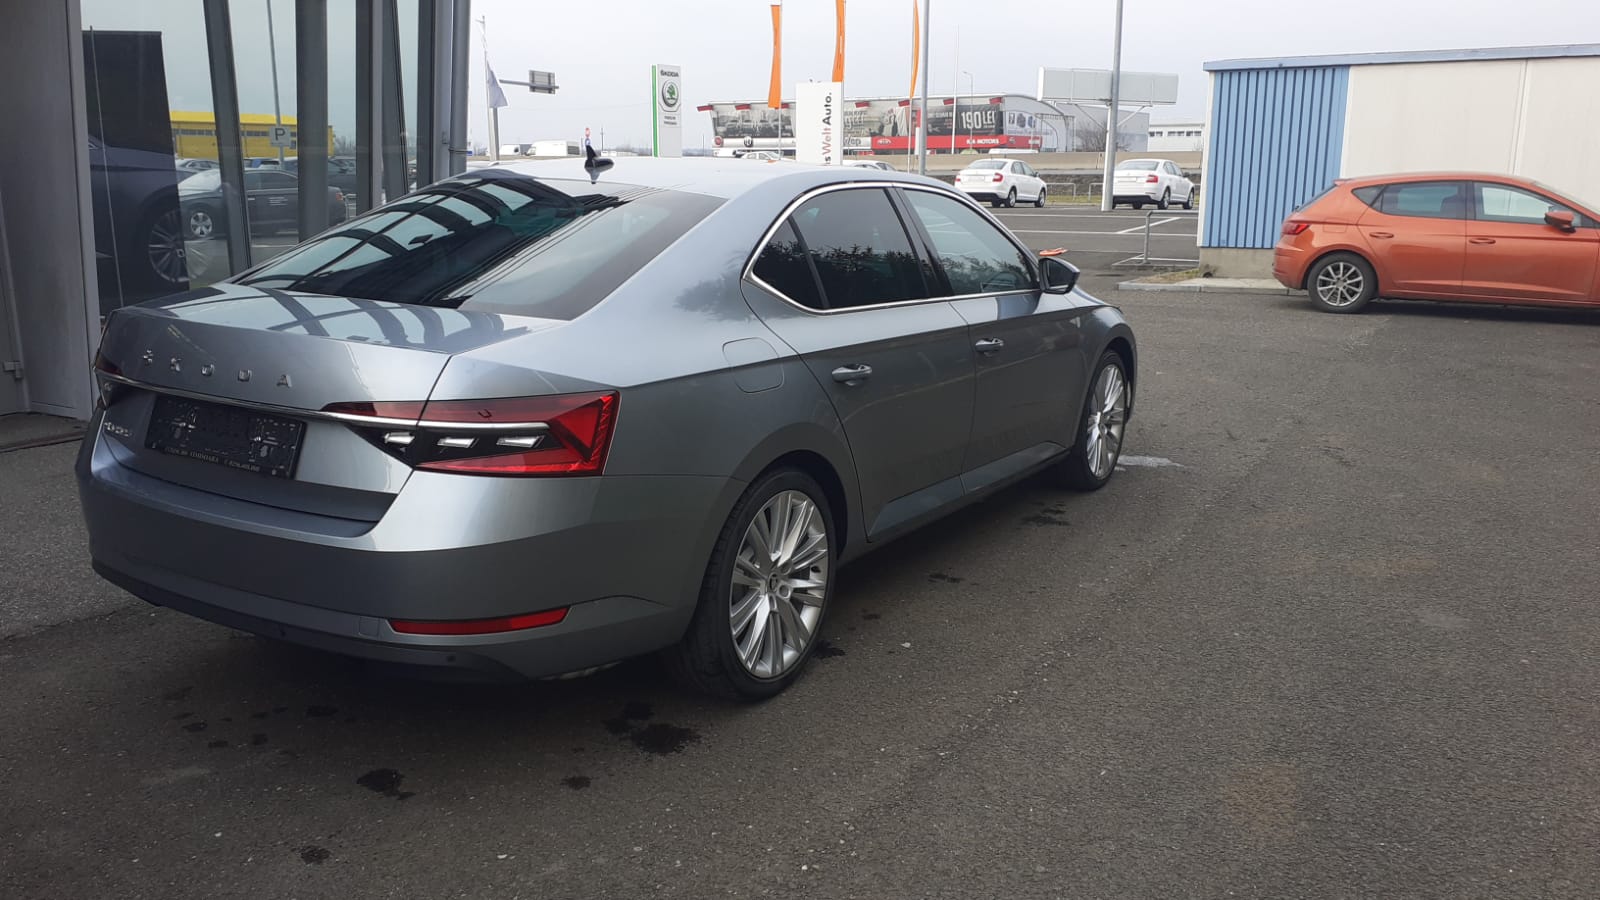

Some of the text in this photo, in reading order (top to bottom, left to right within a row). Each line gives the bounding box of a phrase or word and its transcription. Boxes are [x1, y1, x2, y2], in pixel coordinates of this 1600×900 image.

[961, 111, 982, 129] 190
[983, 110, 996, 124] LEI
[275, 128, 286, 141] P
